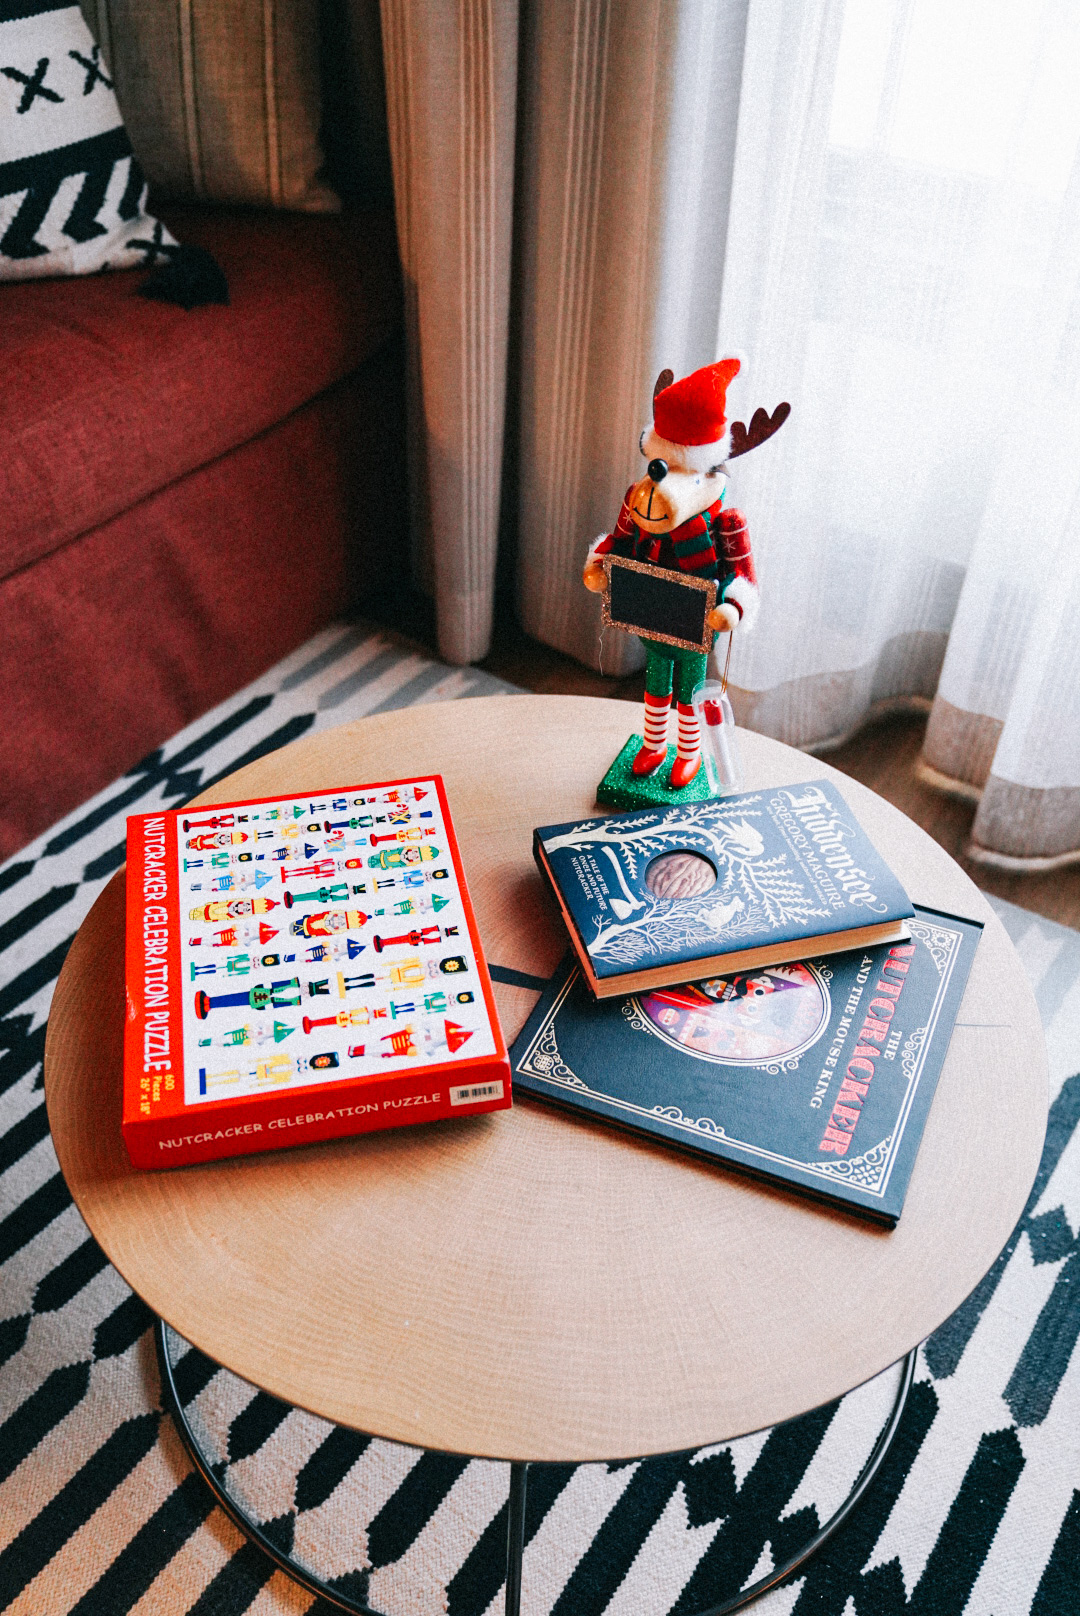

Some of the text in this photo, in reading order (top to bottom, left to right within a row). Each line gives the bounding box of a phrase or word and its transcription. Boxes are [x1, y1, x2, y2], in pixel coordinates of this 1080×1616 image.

[589, 858, 600, 875] TALE
[769, 798, 846, 911] GREGORY MAGUIRE
[570, 856, 594, 901] NUTCRACKER
[578, 855, 608, 911] ONCE AND FUTURE
[595, 874, 604, 882] OF
[599, 881, 610, 896] THE
[143, 816, 172, 1073] NUTCRACKER CELEBRATION PUZZLE
[809, 954, 874, 1110] AND THE MOUSE KING
[818, 943, 917, 1156] NUTCRACKER
[884, 1030, 903, 1061] THE
[152, 1075, 163, 1102] Pieces
[164, 1074, 175, 1091] 600
[158, 1092, 441, 1150] NUTCRACKER CELEBRATION PUZZLE
